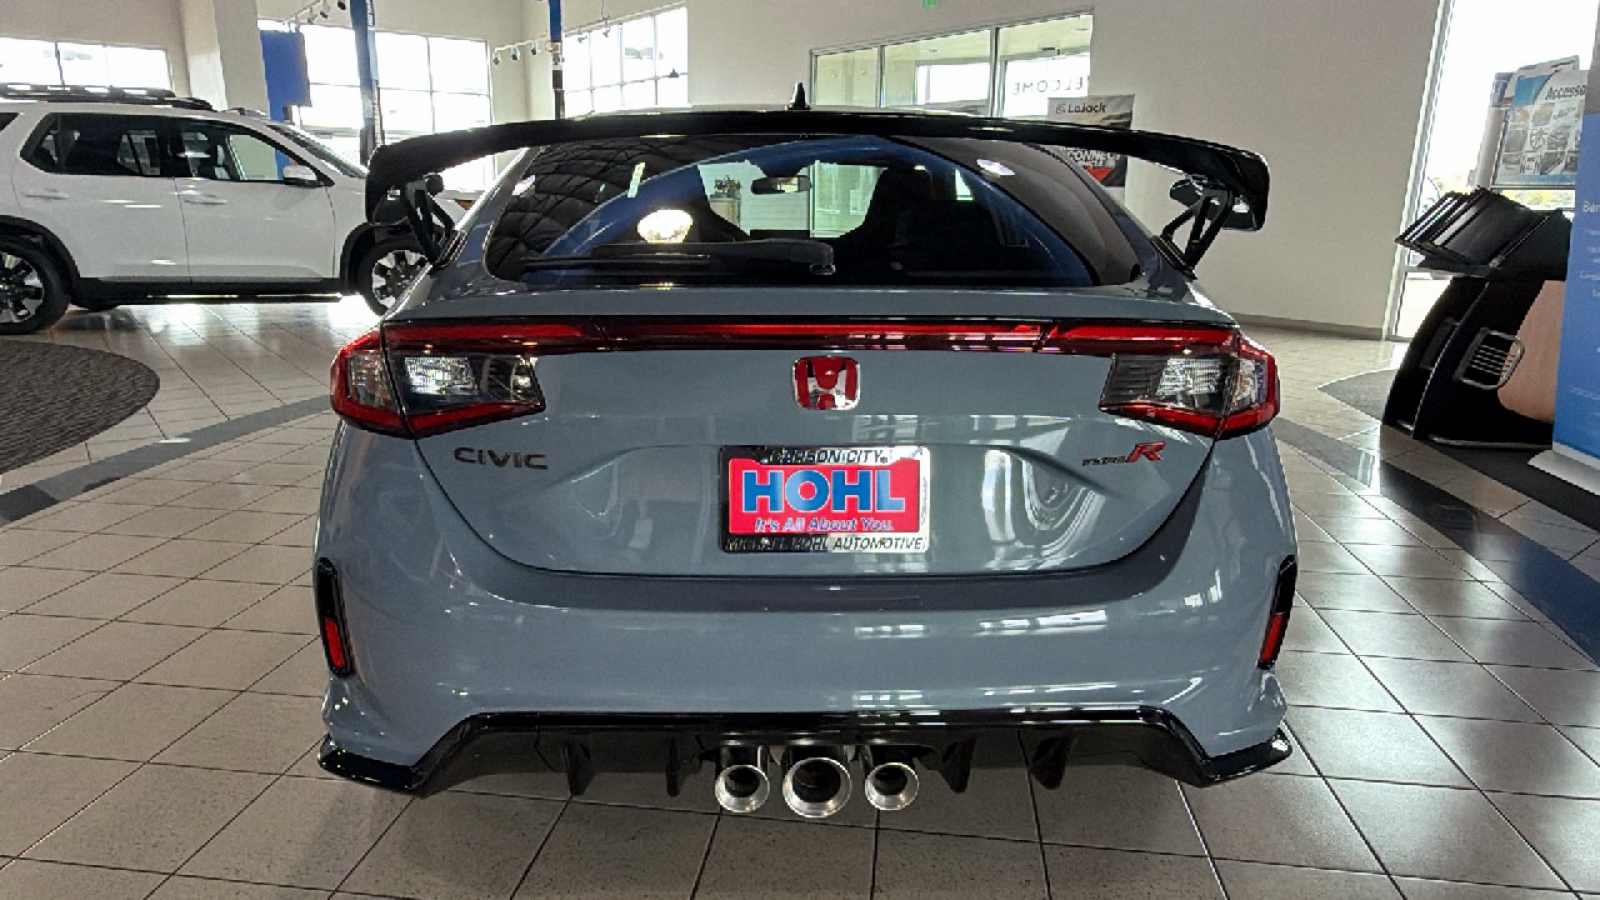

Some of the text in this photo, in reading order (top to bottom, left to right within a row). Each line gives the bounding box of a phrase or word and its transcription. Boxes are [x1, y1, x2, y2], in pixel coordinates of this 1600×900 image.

[454, 447, 548, 470] CIVIC
[844, 449, 883, 463] CITY
[742, 469, 906, 513] HOHL
[755, 517, 894, 531] It's All About You.
[833, 536, 923, 551] AUTOMOTIVE
